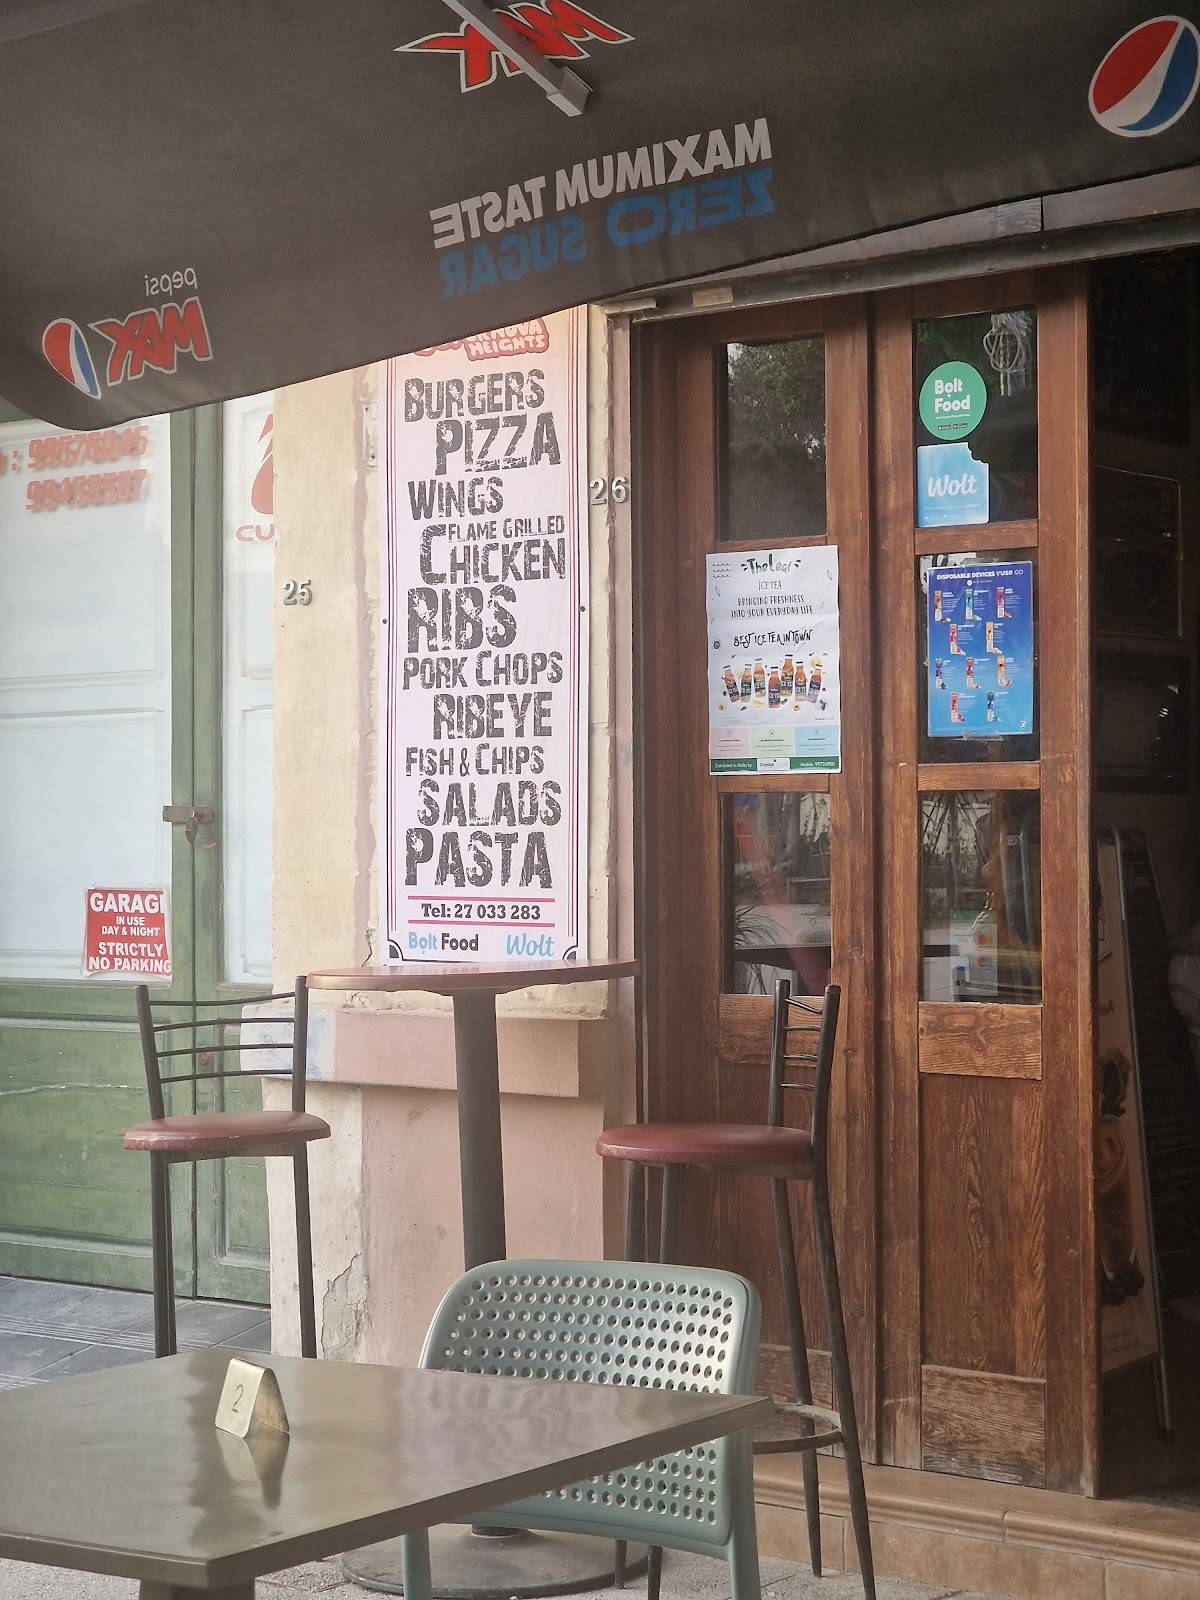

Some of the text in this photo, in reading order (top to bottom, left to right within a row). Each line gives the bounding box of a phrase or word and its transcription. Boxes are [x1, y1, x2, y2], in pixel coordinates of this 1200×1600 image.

[468, 334, 545, 357] HEIGHTS
[404, 368, 545, 423] BURGERS
[934, 378, 963, 395] Bolt
[934, 394, 971, 413] Food
[435, 411, 561, 476] PIZZA
[589, 475, 629, 505] 26
[927, 473, 978, 497] Wolt
[407, 476, 504, 521] WINGS
[448, 515, 565, 543] FLAME GRILLED
[419, 523, 566, 586] CHICKEN
[769, 580, 782, 590] TEA
[936, 572, 971, 580] DISPOSABLE
[971, 571, 996, 579] DEVICES
[281, 579, 312, 606] 25
[769, 594, 805, 605] FRESHNESS
[407, 584, 517, 653] RIBS
[731, 605, 813, 619] INTO YOUR EVERYDAY LIFE
[733, 632, 755, 649] BEST
[754, 634, 767, 646] ICE
[767, 631, 785, 646] TEA
[402, 650, 563, 691] PORK CHOPS
[433, 691, 552, 740] RIBEYE
[405, 742, 545, 777] FISH & CHIPS
[417, 778, 562, 827] SALADS
[404, 827, 553, 889] PASTA
[116, 915, 145, 926] IN USE
[421, 903, 541, 920] Tel: 27 033 283
[101, 925, 160, 937] DAY & NIGHT
[408, 931, 555, 957] Bolt Food Wolt
[98, 941, 164, 957] STRICTLY
[88, 956, 172, 974] NO PARKING
[231, 1383, 244, 1414] 2
